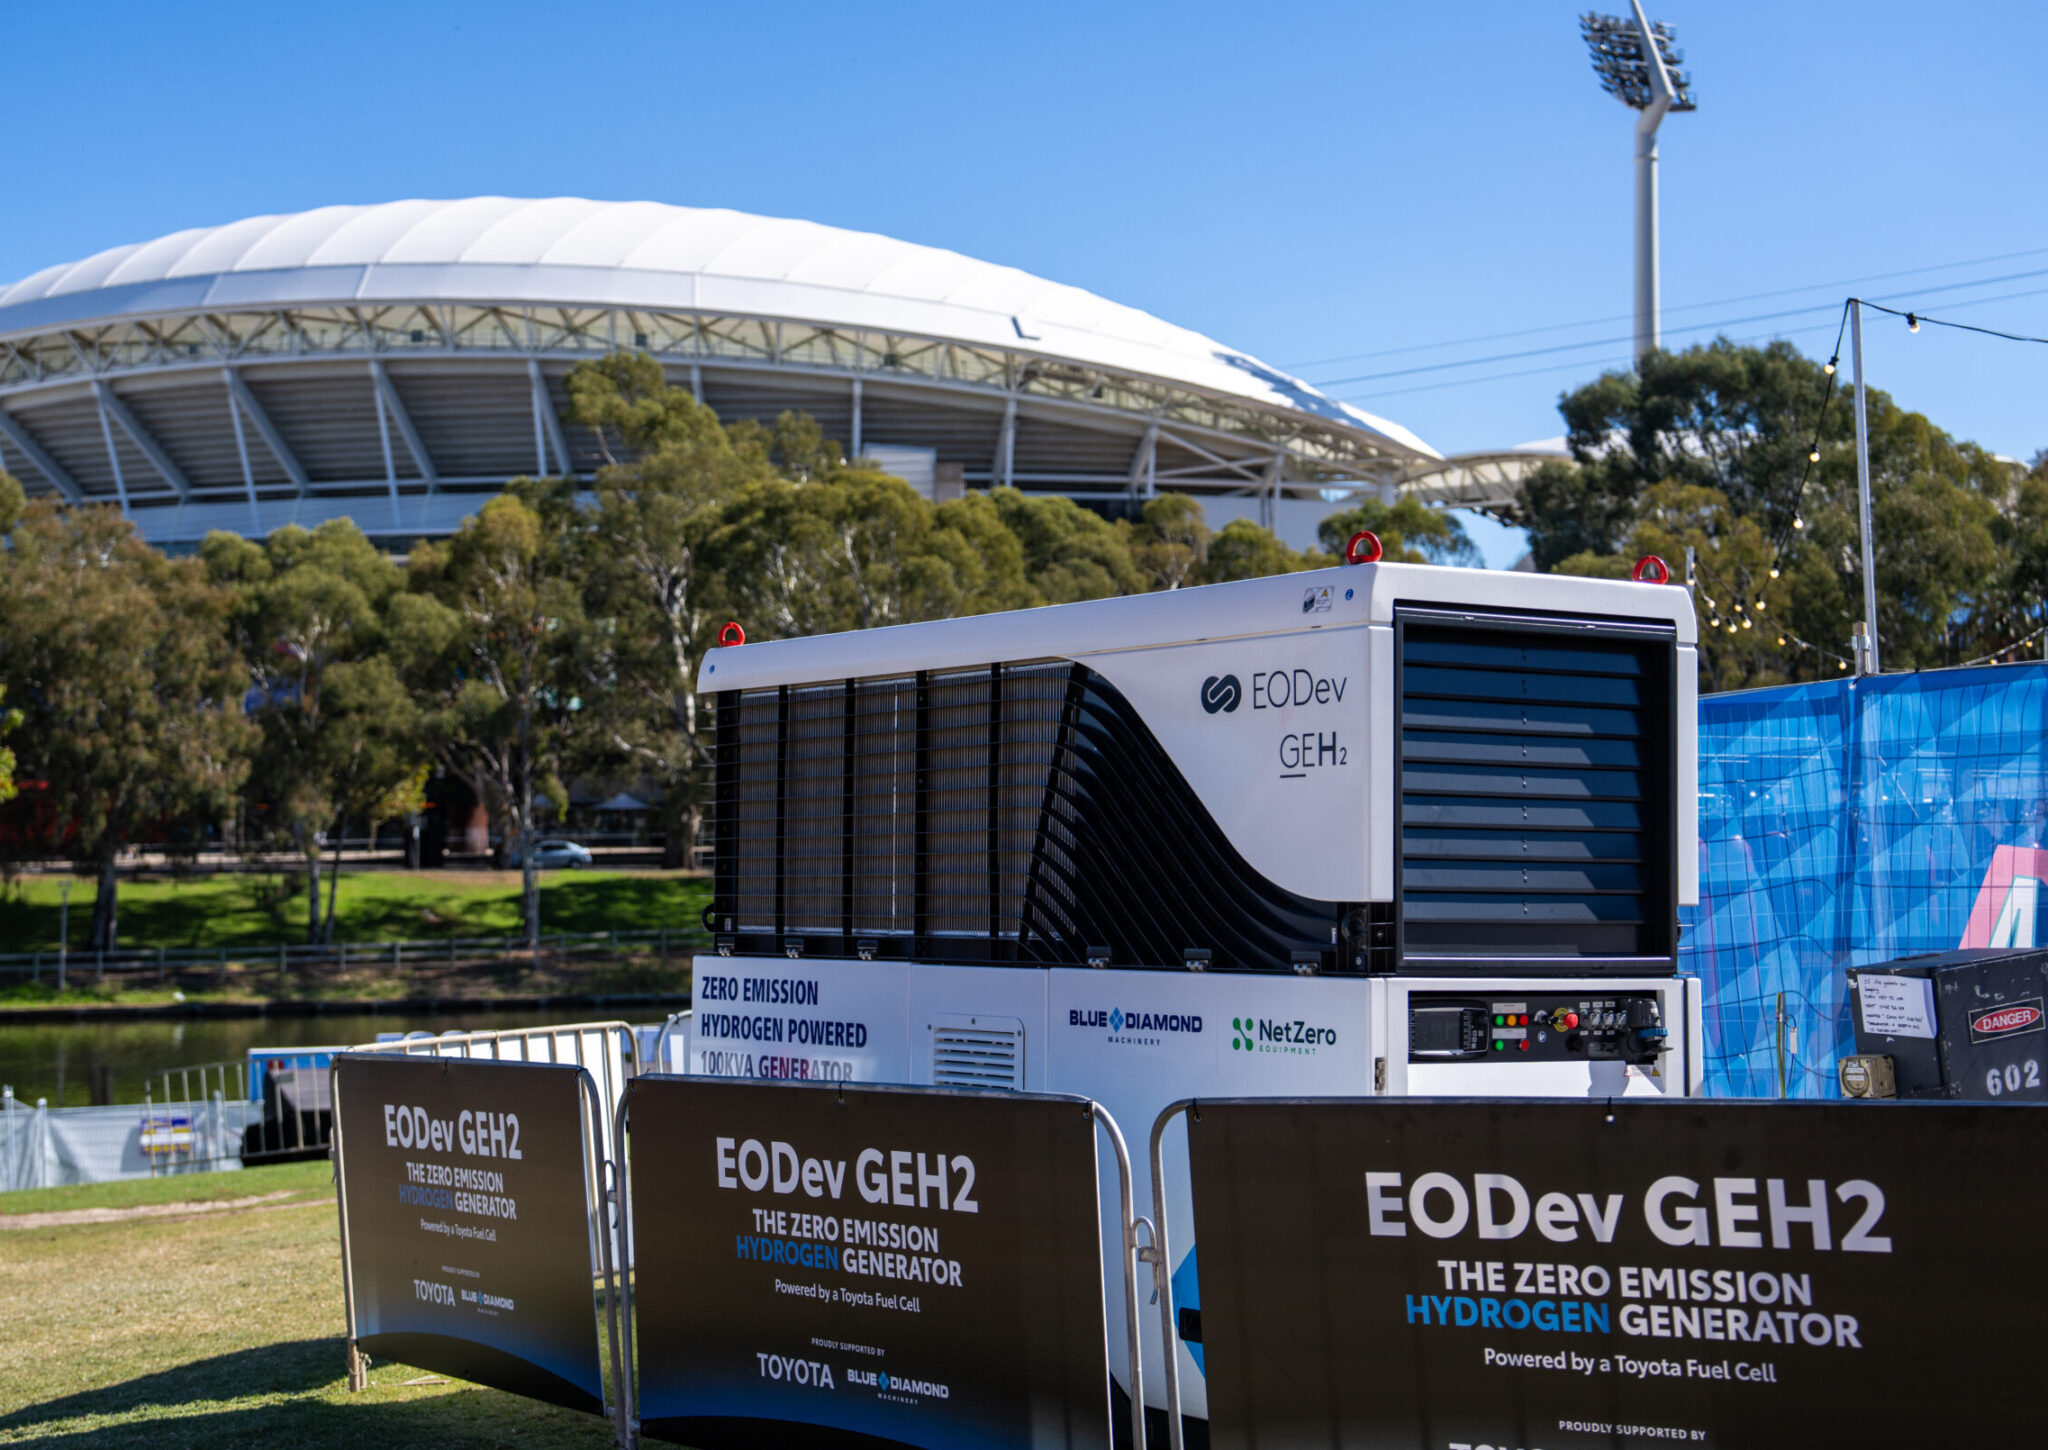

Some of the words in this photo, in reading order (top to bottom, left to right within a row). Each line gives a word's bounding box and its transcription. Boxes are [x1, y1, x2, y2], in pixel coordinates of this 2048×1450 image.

[1253, 669, 1347, 709] EODev
[702, 976, 738, 1001] ZERO
[743, 978, 818, 1005] EMISSION
[701, 1013, 783, 1042] HYDROGEN
[788, 1019, 867, 1048] POWERED
[1069, 1009, 1107, 1027] BLUE
[1125, 1012, 1203, 1033] DIAMOND
[1259, 1018, 1337, 1045] NetZero
[1982, 1010, 2032, 1030] DANGER
[1108, 1036, 1161, 1046] MACHINERY
[1259, 1045, 1317, 1055] EQUIPMENT
[701, 1051, 754, 1077] 100KVA
[759, 1055, 853, 1081] GENERATOR
[1986, 1059, 2040, 1096] 602
[384, 1104, 454, 1152] EODev
[458, 1109, 522, 1160] GEH2
[406, 1161, 426, 1183] THE
[426, 1164, 451, 1187] ZERO
[454, 1167, 503, 1193] EMISSION
[716, 1136, 846, 1199] EODev
[855, 1148, 979, 1214] GEH2
[398, 1184, 454, 1211] HYDROGEN
[455, 1191, 517, 1220] GENERATOR
[1365, 1171, 1624, 1242] EODev
[1644, 1175, 1893, 1253] GEH2
[420, 1218, 443, 1233] Powered
[442, 1220, 450, 1237] by
[455, 1223, 473, 1239] Toyota
[473, 1226, 485, 1240] Fuel
[485, 1228, 496, 1242] Cell
[752, 1208, 787, 1235] THE
[790, 1212, 839, 1241] ZERO
[843, 1218, 939, 1253] EMISSION
[736, 1235, 838, 1270] HYDROGEN
[842, 1248, 962, 1287] GENERATOR
[413, 1280, 456, 1307] TOYOTA
[775, 1279, 817, 1298] Powered
[818, 1284, 831, 1303] by
[832, 1289, 839, 1300] a
[840, 1288, 874, 1307] Toyota
[875, 1292, 898, 1310] Fuel
[899, 1296, 920, 1313] Cell
[1437, 1260, 1505, 1292] THE
[1513, 1262, 1611, 1296] ZERO
[1619, 1266, 1812, 1306] EMISSION
[461, 1289, 477, 1303] BLUE
[483, 1294, 514, 1311] DIAMOND
[1405, 1294, 1610, 1334] HYDROGEN
[1619, 1304, 1863, 1348] GENERATOR
[811, 1337, 839, 1350] PROUDLY
[840, 1342, 876, 1355] SUPPORTED
[877, 1348, 885, 1357] BY
[756, 1352, 835, 1390] TOYOTA
[1484, 1347, 1566, 1370] Powered
[1571, 1352, 1595, 1375] by
[1599, 1358, 1611, 1372] a
[1614, 1355, 1682, 1379] Toyota
[1686, 1359, 1731, 1379] Fuel
[1735, 1362, 1777, 1383] Cell
[847, 1369, 877, 1386] BLUE
[890, 1376, 950, 1399] DIAMOND
[877, 1392, 918, 1406] MACHINERY
[1558, 1420, 1612, 1434] PROUDLY
[1616, 1424, 1687, 1439] SUPPORTED
[1691, 1430, 1706, 1441] BY
